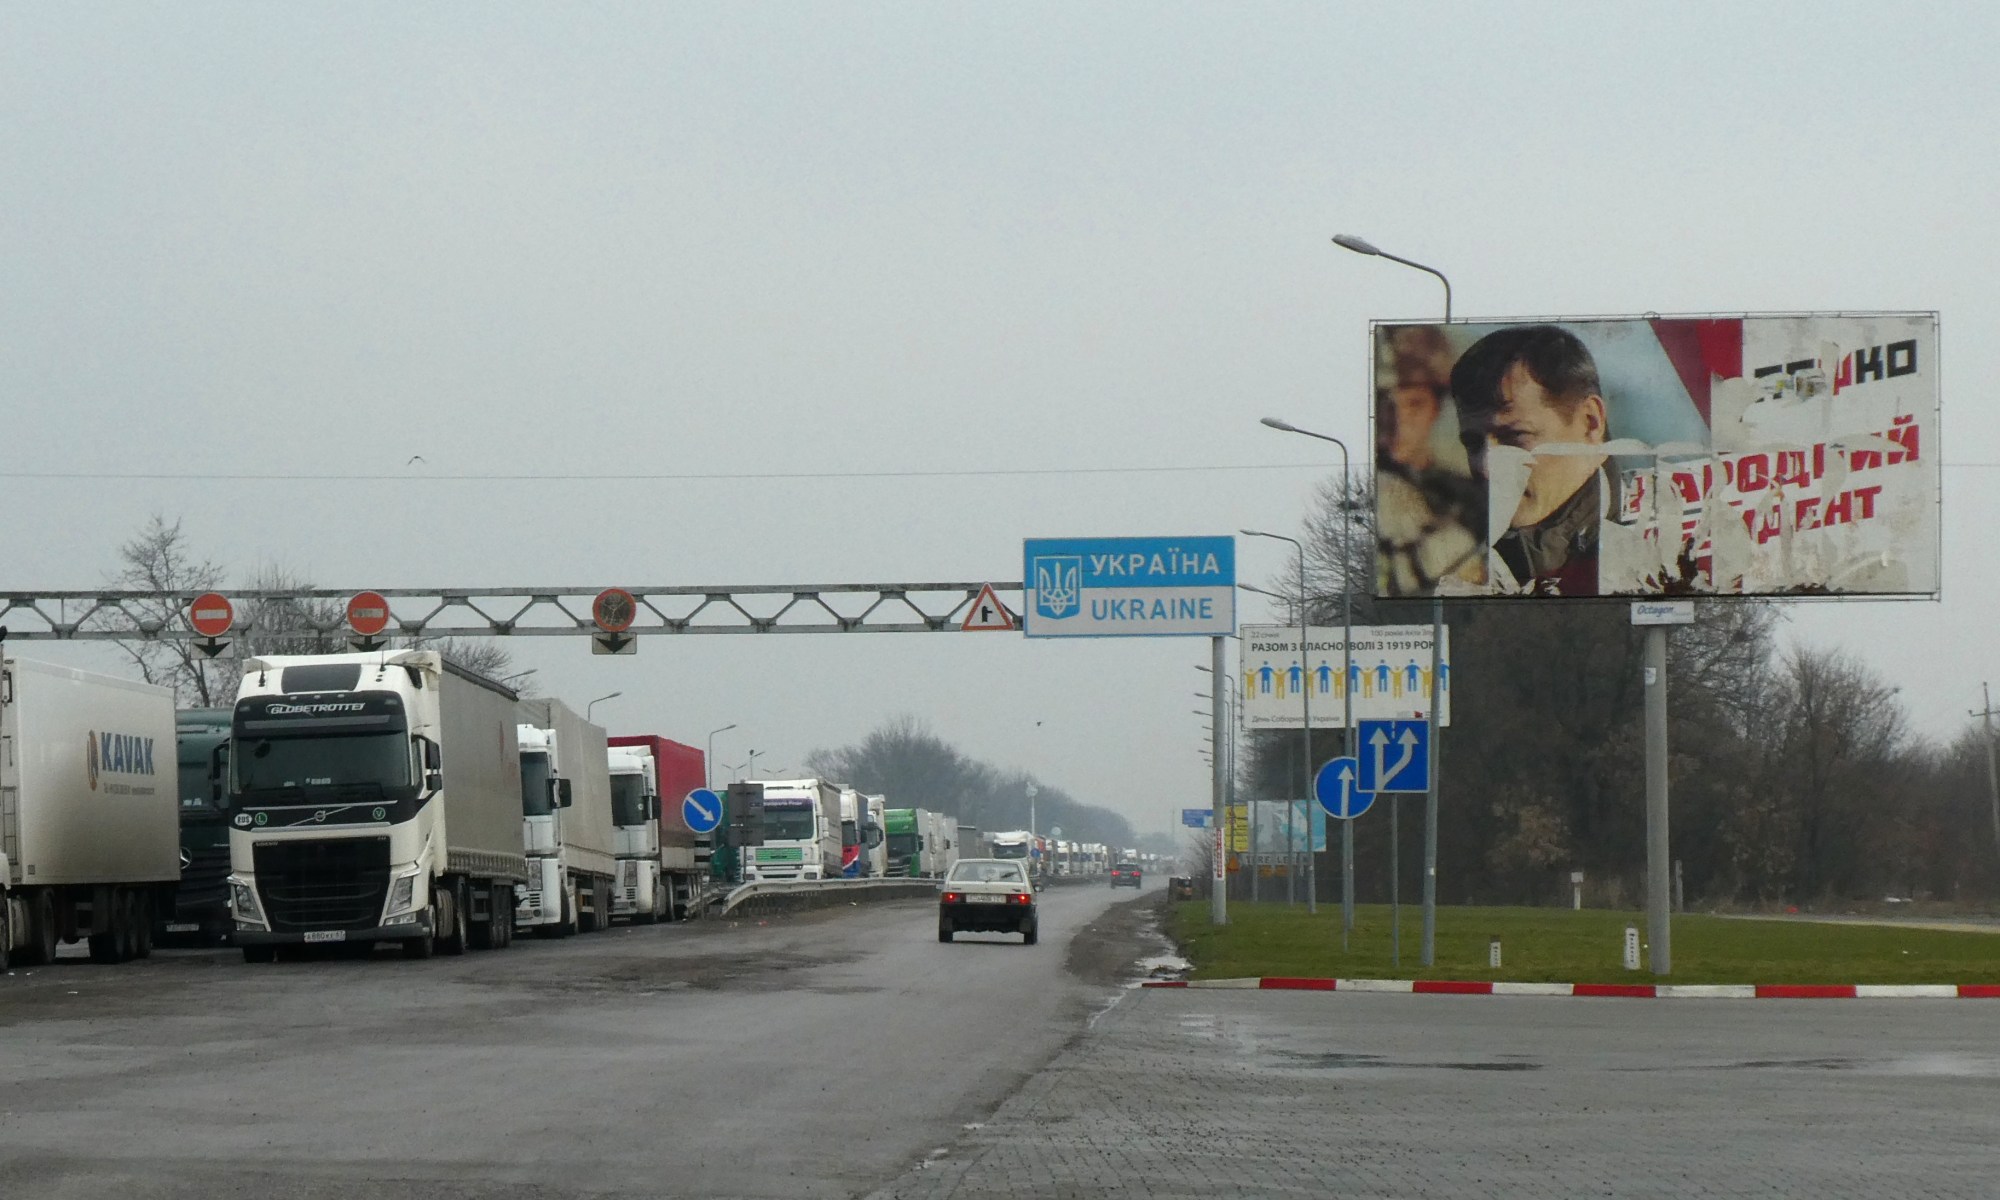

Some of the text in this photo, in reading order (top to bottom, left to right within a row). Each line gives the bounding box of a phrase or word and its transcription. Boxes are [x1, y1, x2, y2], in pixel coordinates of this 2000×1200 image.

[1090, 547, 1220, 576] УКРАЇНА
[1091, 598, 1213, 621] UKRAINE
[1637, 604, 1674, 618] Octagon
[1251, 642, 1289, 652] РАЗОМ
[1387, 641, 1411, 650] 1919
[101, 731, 155, 776] KAVAK
